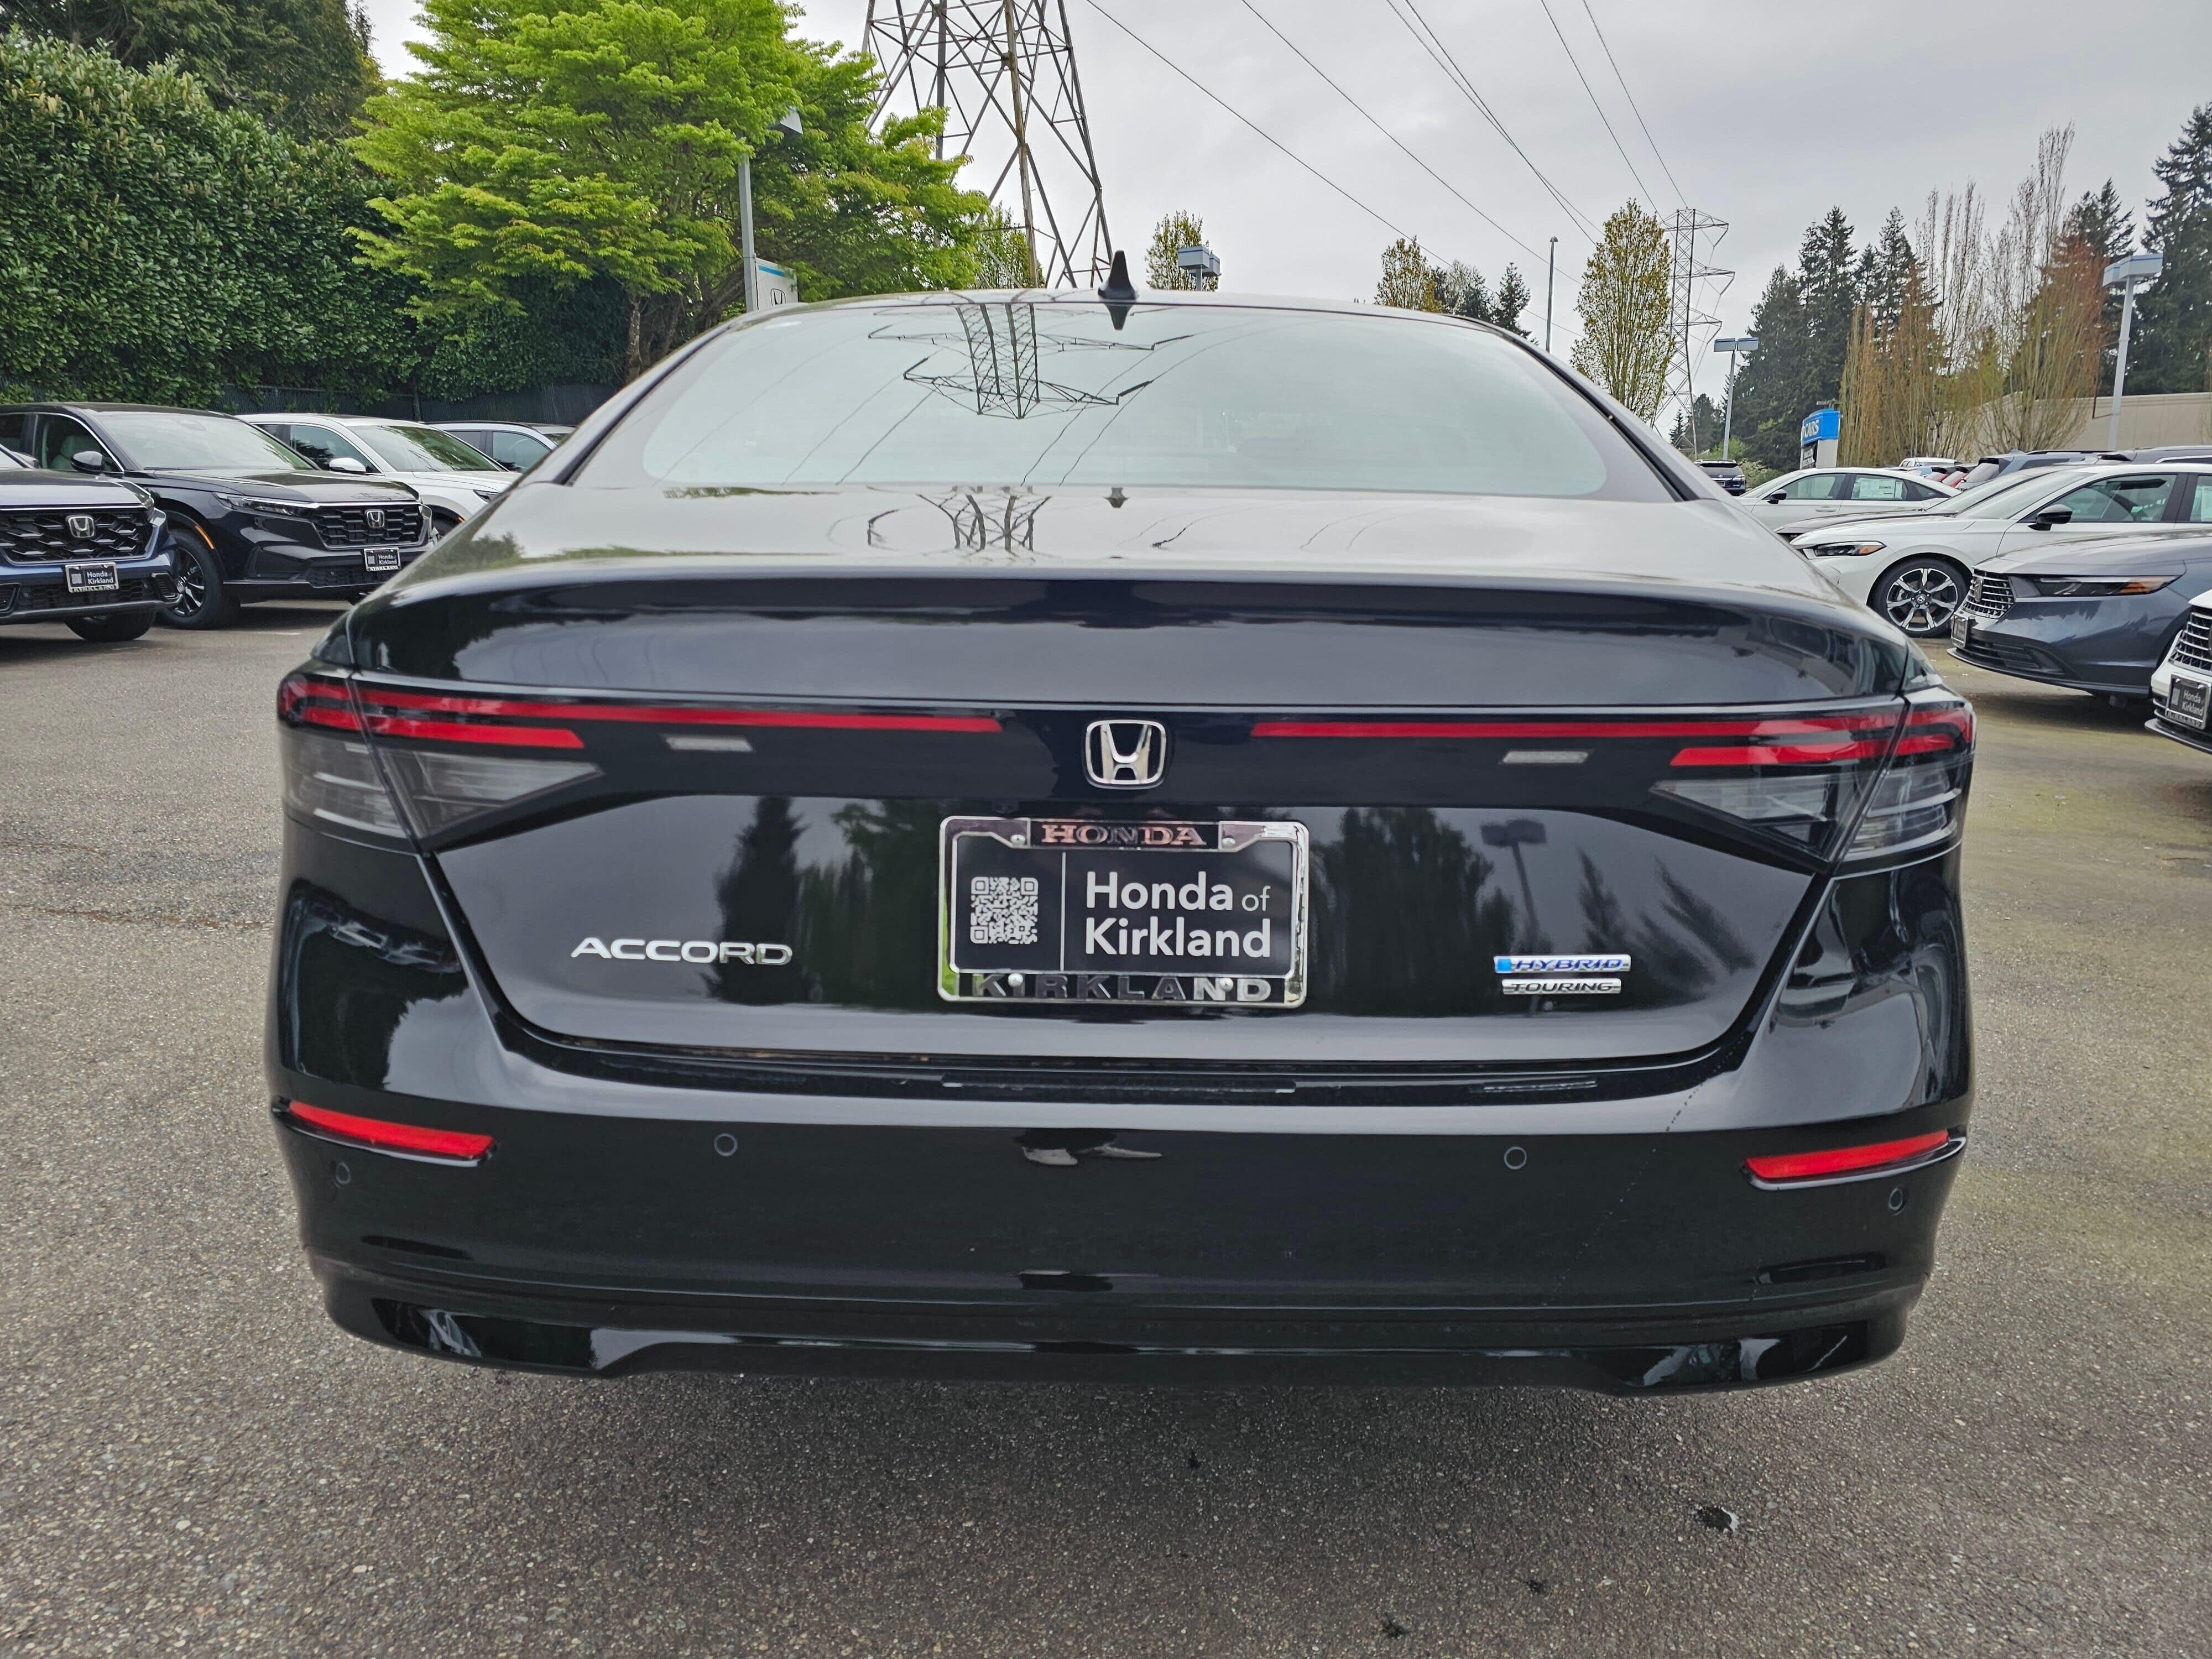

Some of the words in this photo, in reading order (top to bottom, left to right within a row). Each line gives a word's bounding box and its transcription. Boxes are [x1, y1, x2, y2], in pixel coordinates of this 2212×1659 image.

[1804, 420, 1819, 438] CARS
[2183, 690, 2201, 703] Honda
[2182, 701, 2204, 716] Kirkland
[1042, 825, 1207, 846] HONDA
[1087, 871, 1233, 911] Honda
[1241, 885, 1271, 911] of
[1086, 916, 1271, 958] Kirkland
[571, 937, 792, 965] ACCORD
[1515, 959, 1623, 971] HYBRID
[1511, 982, 1614, 993] TOURING
